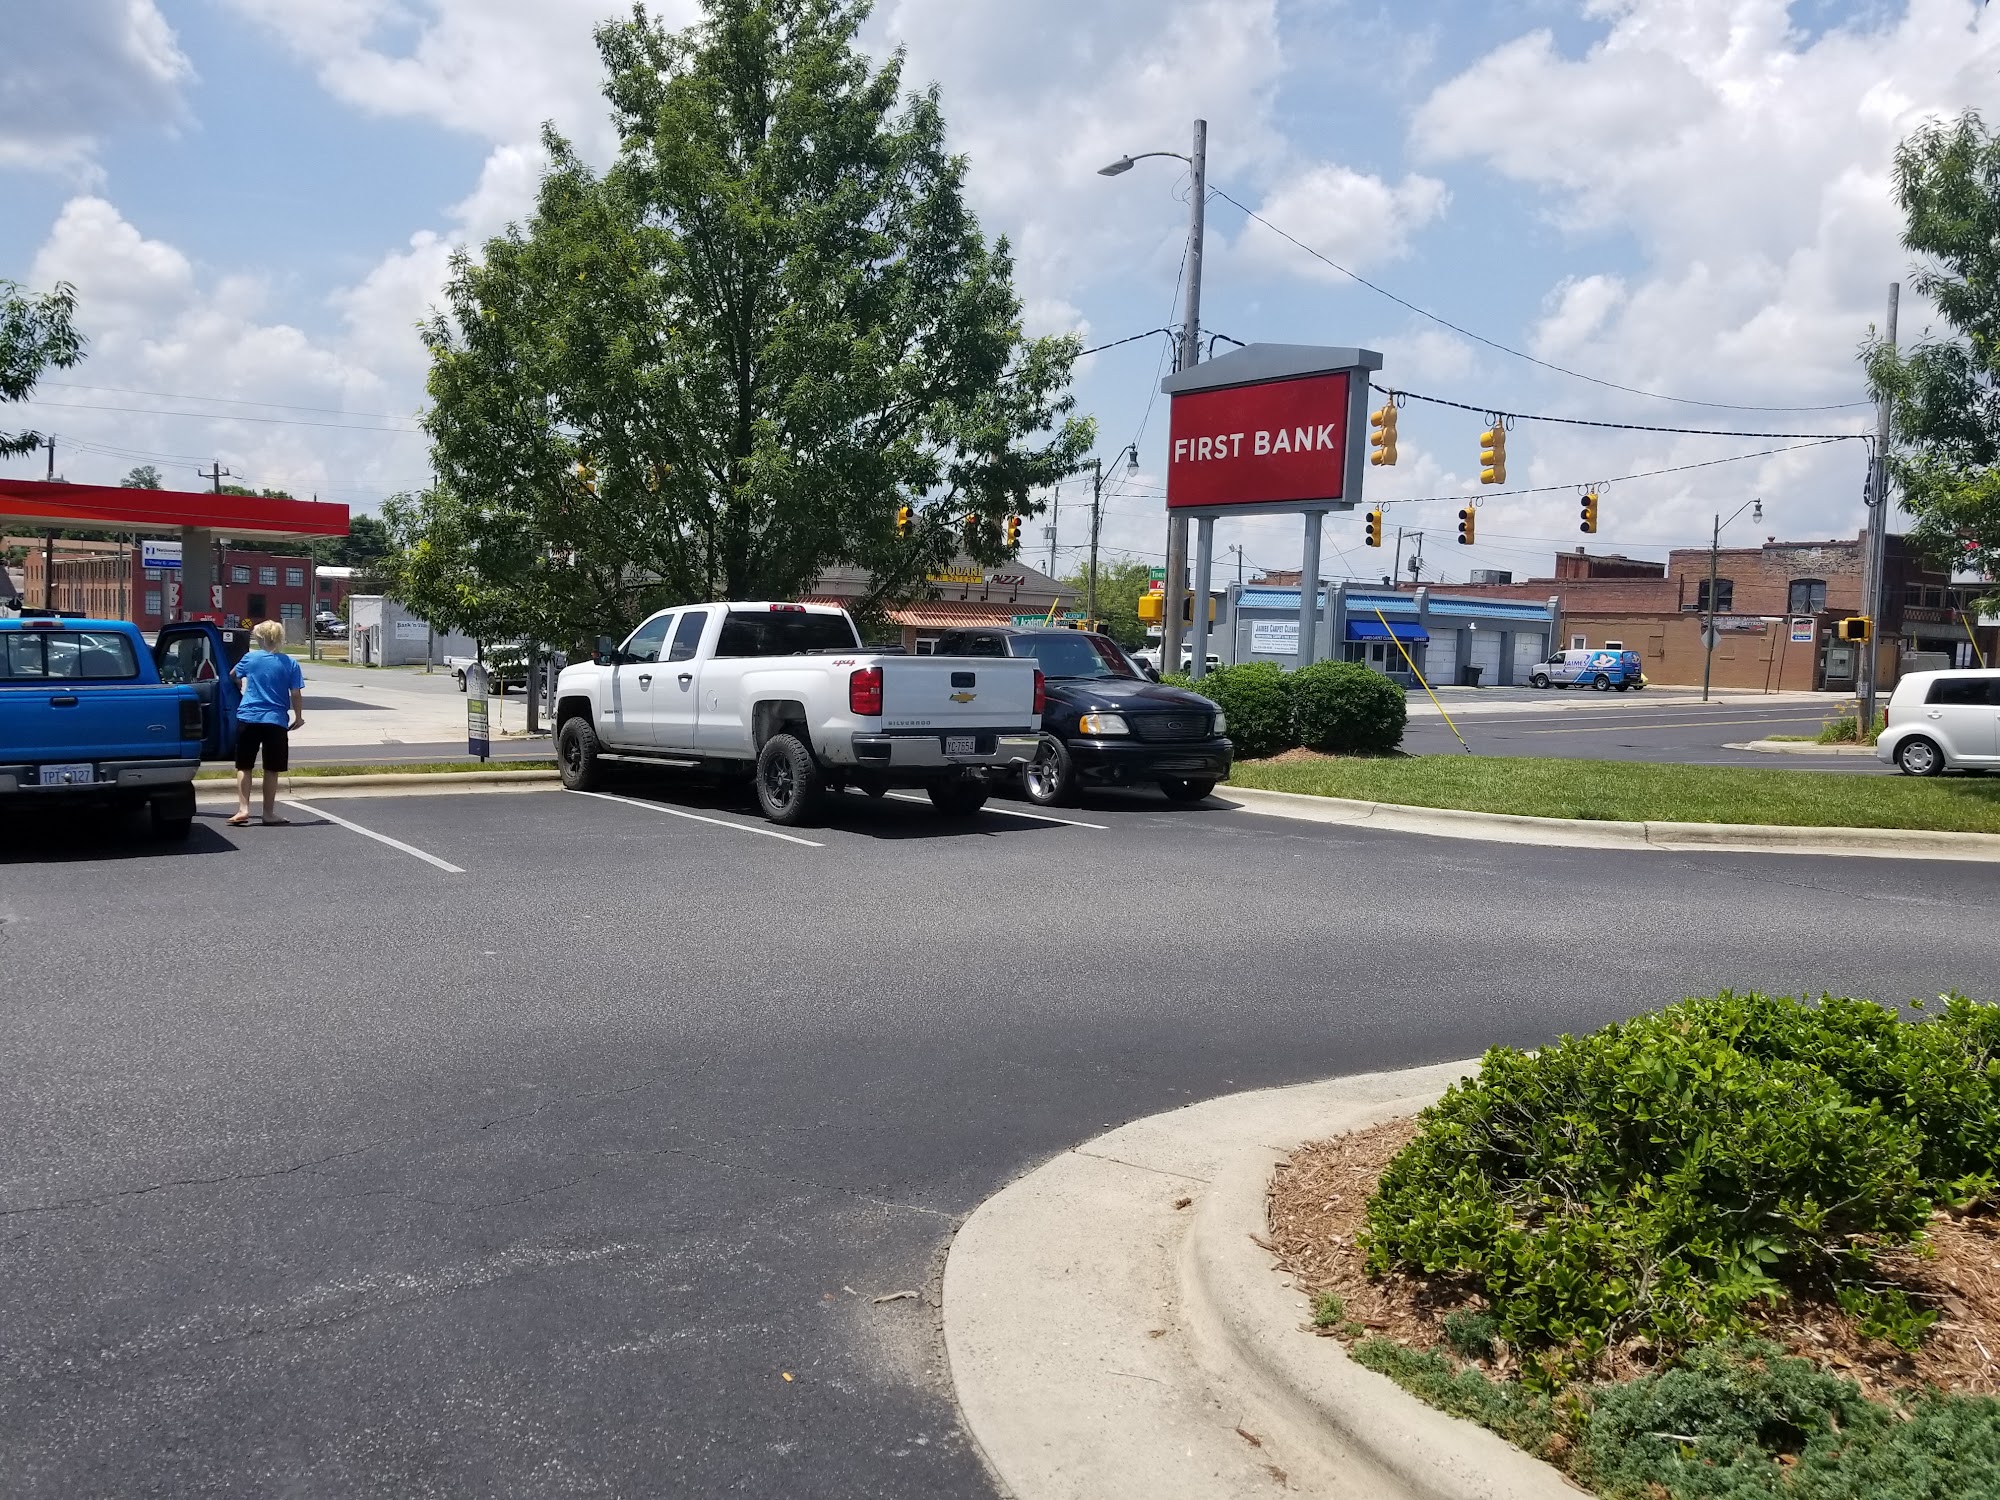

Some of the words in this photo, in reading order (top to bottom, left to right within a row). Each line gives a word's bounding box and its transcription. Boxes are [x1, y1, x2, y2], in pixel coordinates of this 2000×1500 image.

[1173, 432, 1245, 464] FIRST
[1253, 423, 1336, 456] BANK
[990, 573, 1025, 585] PIZZA
[947, 741, 974, 752] YC-7654
